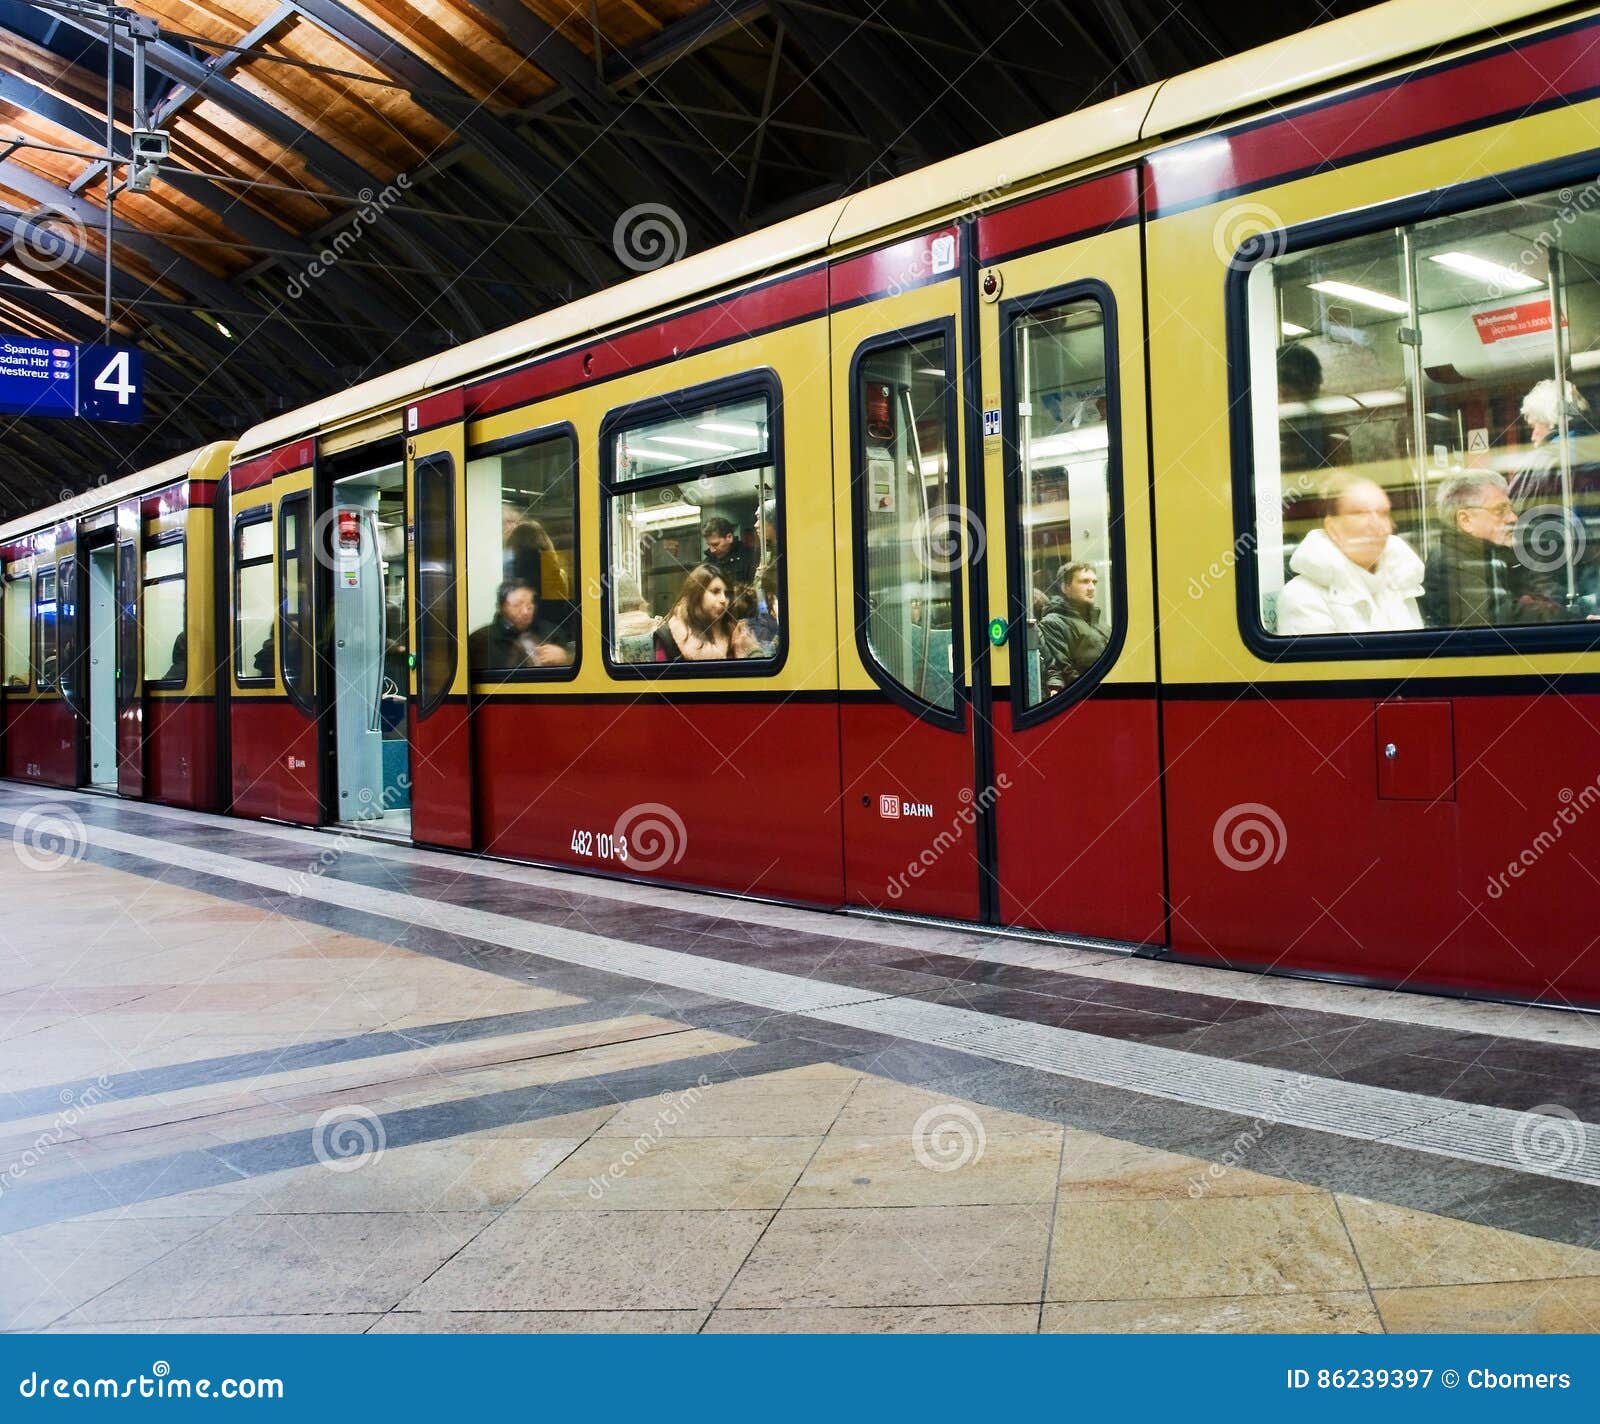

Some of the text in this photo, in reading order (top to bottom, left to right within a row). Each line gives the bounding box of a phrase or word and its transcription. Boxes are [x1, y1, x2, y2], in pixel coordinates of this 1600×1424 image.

[31, 357, 49, 367] Hbf
[94, 351, 136, 405] 4
[882, 797, 933, 818] DB BAHN
[571, 829, 628, 861] 482 101-3
